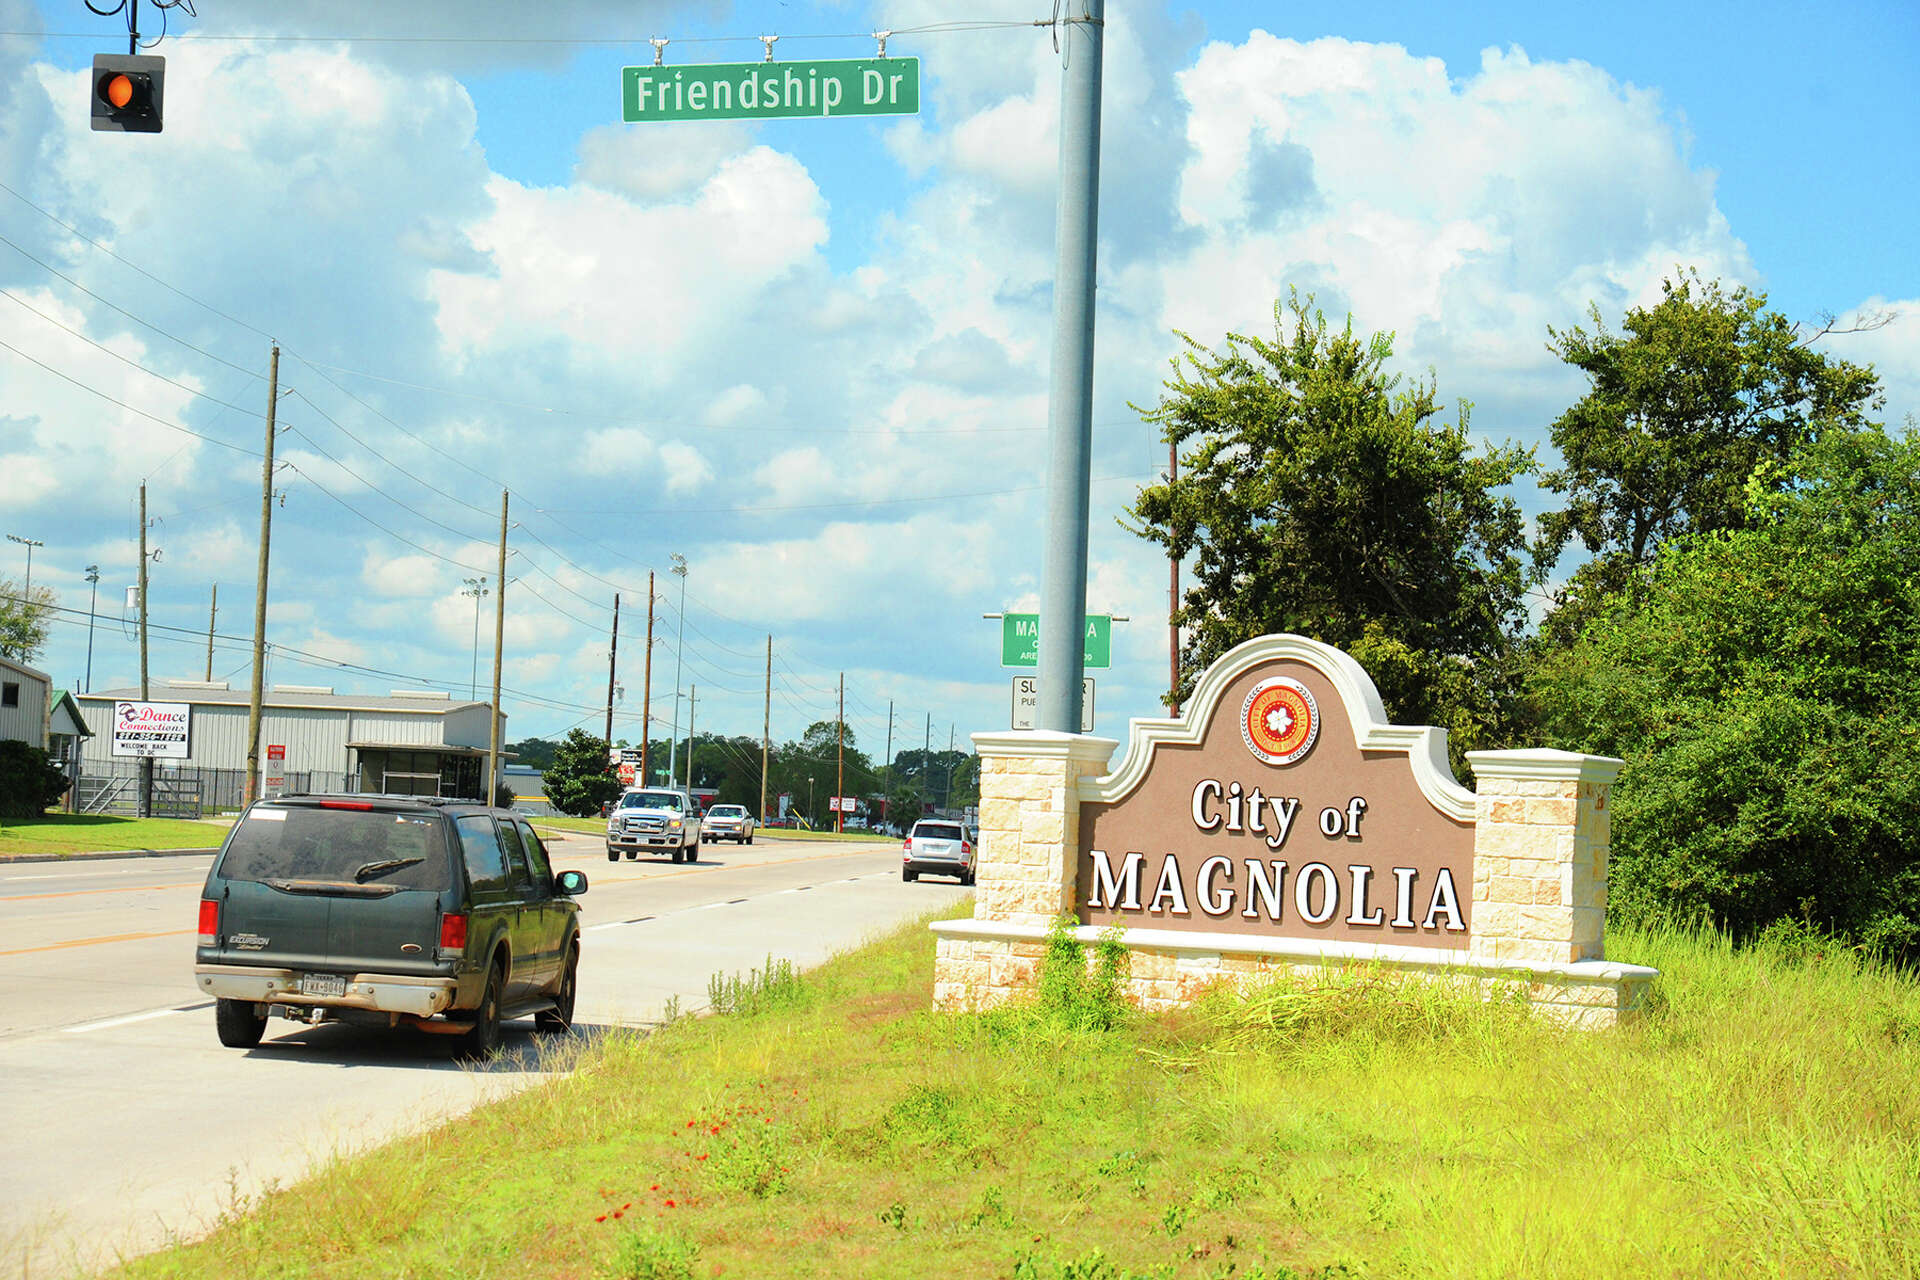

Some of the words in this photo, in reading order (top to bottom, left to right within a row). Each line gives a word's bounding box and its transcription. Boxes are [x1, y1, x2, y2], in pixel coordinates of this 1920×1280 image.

[637, 68, 842, 116] Friendship
[863, 70, 903, 105] Dr
[120, 721, 184, 732] Connections
[139, 707, 186, 722] Dance
[1191, 779, 1299, 848] City
[1320, 797, 1367, 838] of
[1088, 850, 1466, 931] MAGNOLIA
